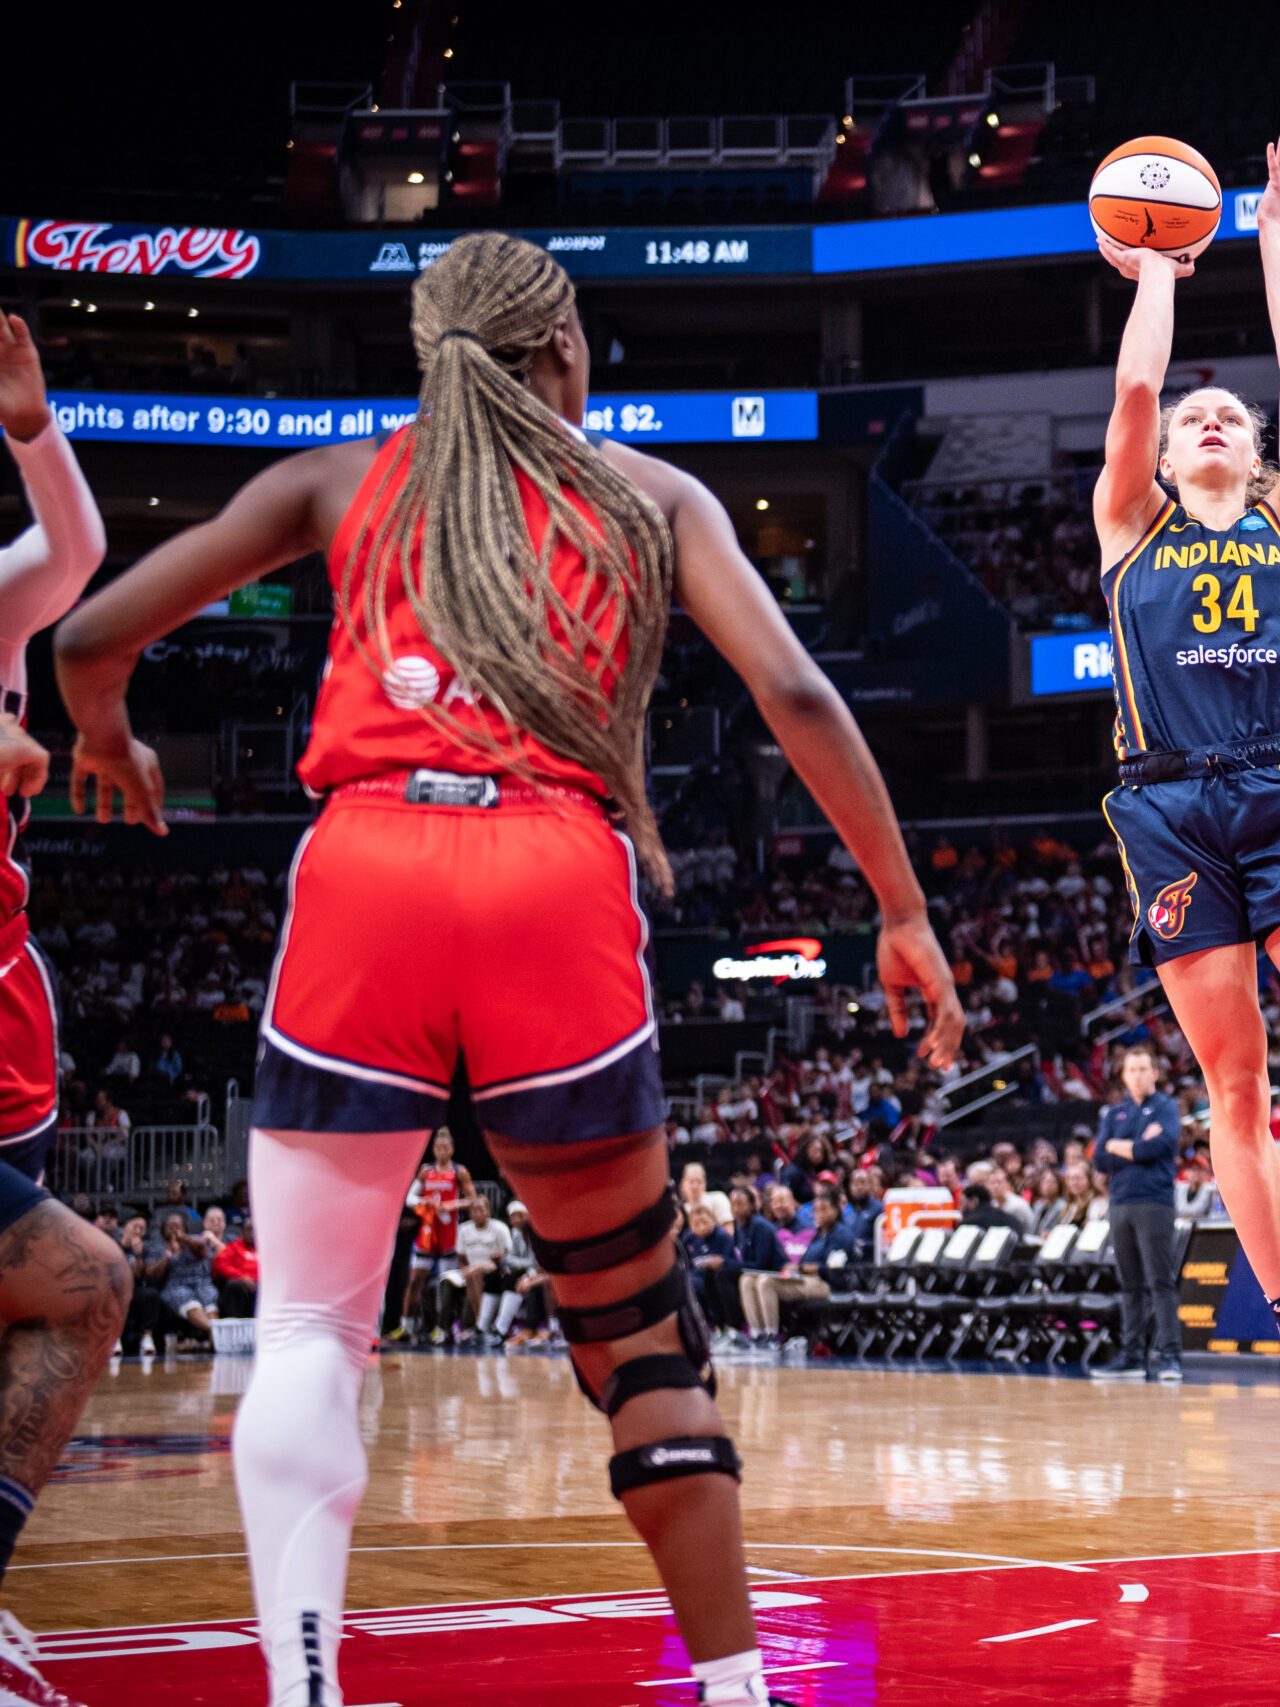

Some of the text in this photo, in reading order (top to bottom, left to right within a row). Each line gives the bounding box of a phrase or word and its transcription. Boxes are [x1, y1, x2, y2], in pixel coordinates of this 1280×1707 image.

[28, 220, 260, 279] Fever
[645, 240, 749, 265] 11:48 AM
[50, 401, 125, 434] ights
[133, 404, 200, 431] after
[207, 406, 271, 435] 9:30
[278, 409, 332, 436] and
[339, 408, 373, 436] all
[621, 403, 663, 433] $2.
[1192, 573, 1260, 633] 34
[1073, 641, 1112, 680] Ri
[1176, 644, 1278, 668] salesforce
